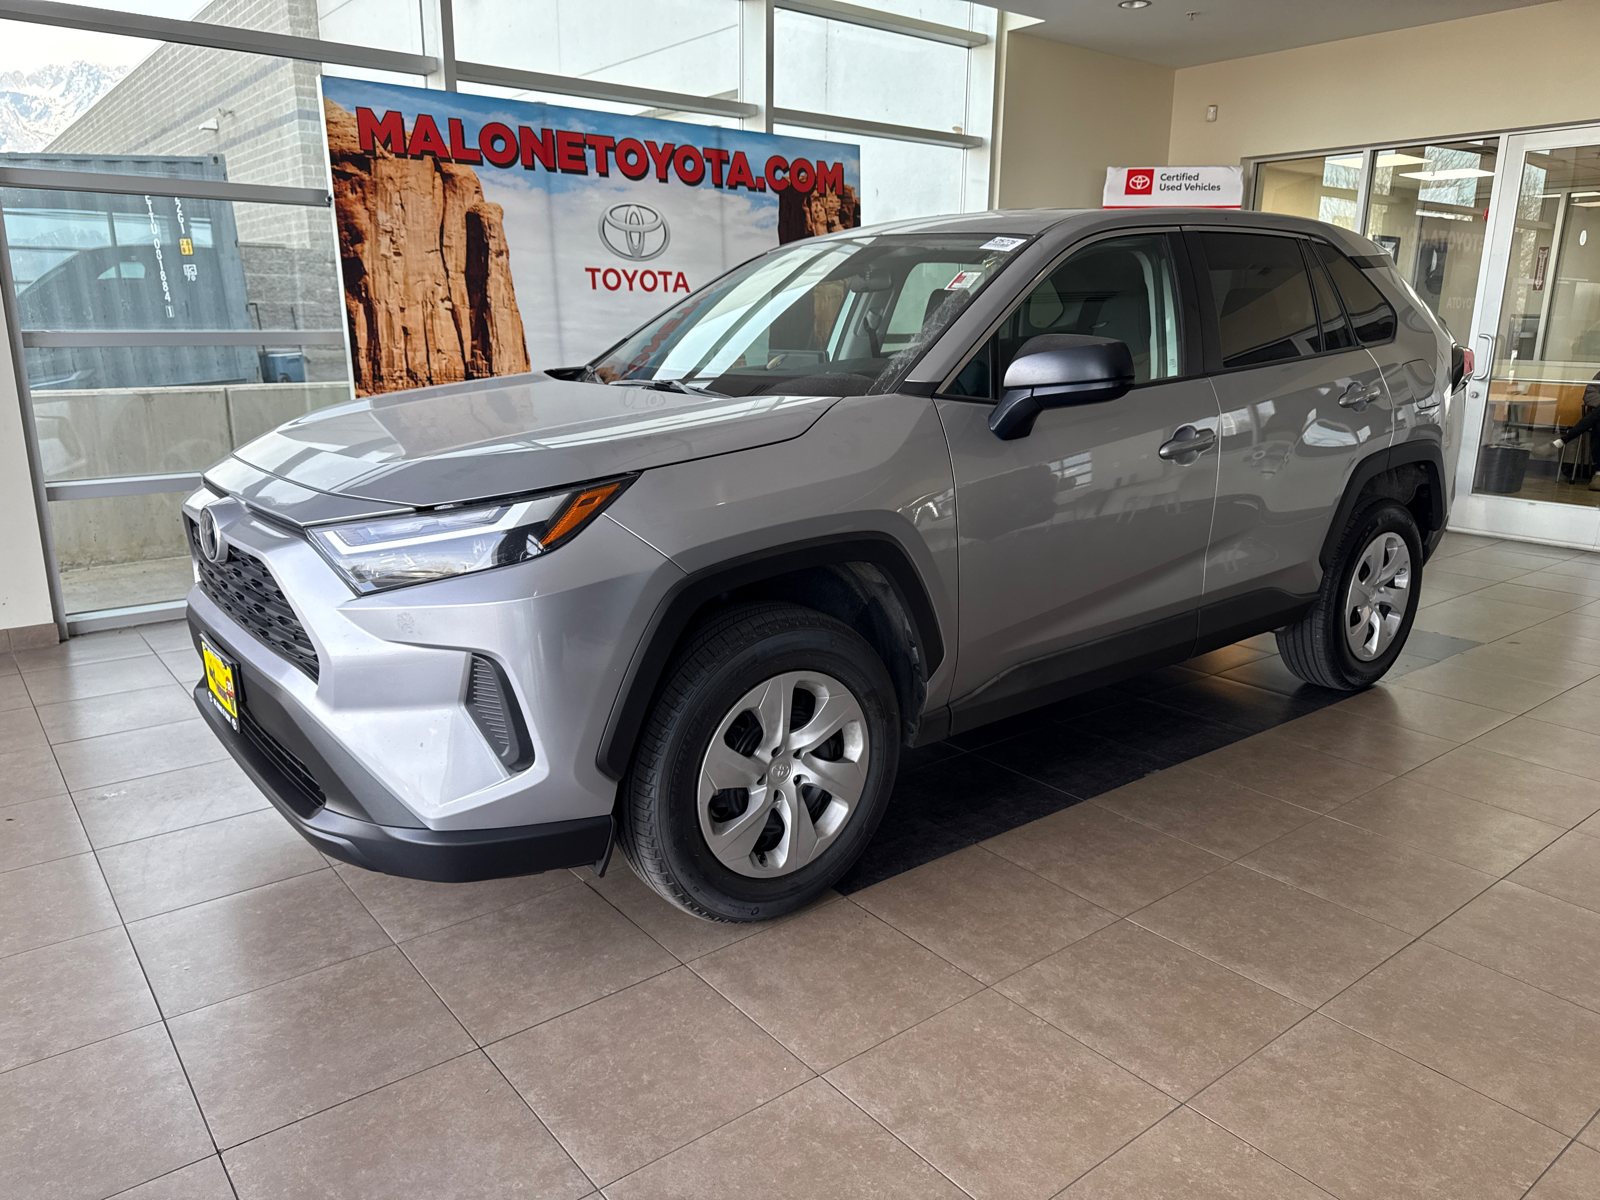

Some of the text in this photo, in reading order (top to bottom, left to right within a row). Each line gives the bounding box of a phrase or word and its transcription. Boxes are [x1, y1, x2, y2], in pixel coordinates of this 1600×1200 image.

[355, 107, 844, 197] MALONETOYOTA.COM
[1160, 173, 1200, 182] Certified
[1159, 183, 1221, 192] Used Vehicles
[584, 267, 691, 294] TOYOTA
